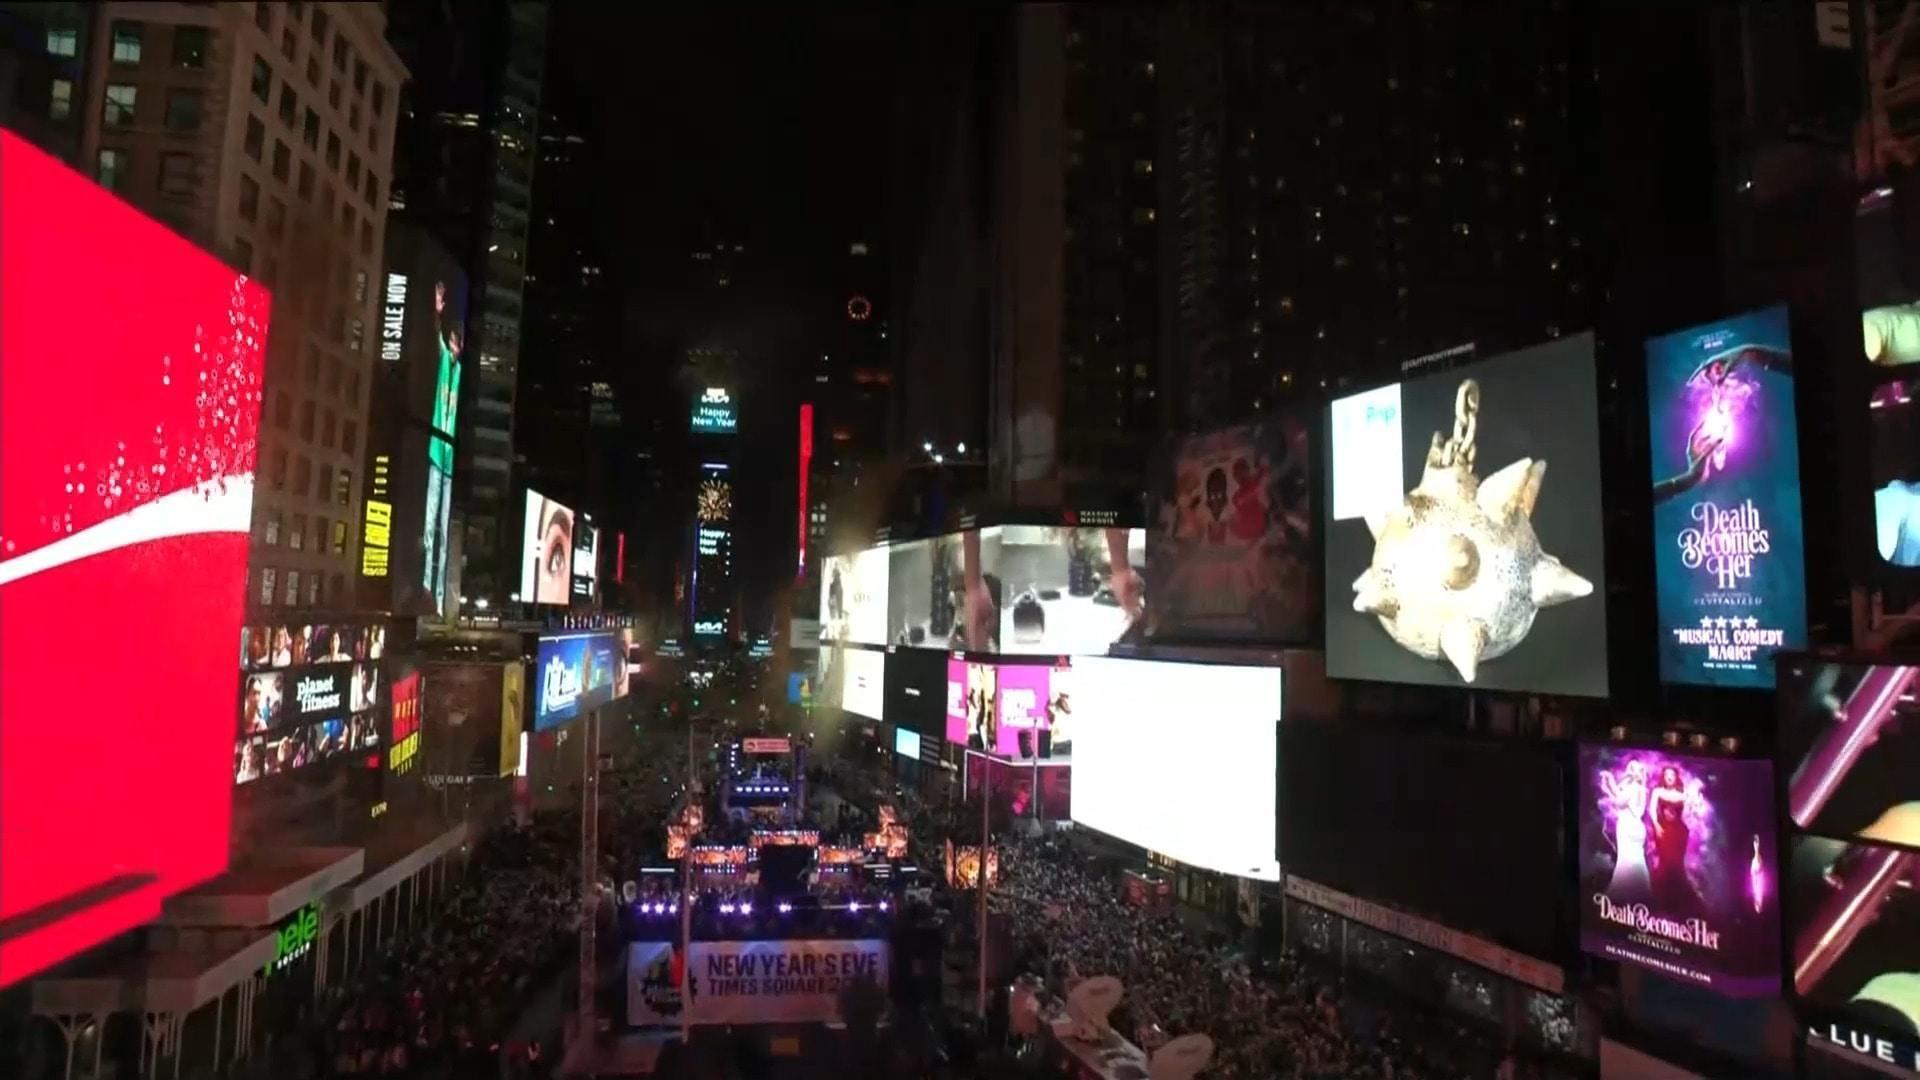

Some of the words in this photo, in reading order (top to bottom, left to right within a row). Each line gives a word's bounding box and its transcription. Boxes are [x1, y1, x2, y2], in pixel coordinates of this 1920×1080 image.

[386, 273, 407, 303] NOW
[383, 306, 404, 339] SALE
[382, 342, 401, 360] ON
[692, 415, 713, 426] New
[716, 416, 737, 428] Year
[700, 406, 730, 419] Happy
[373, 456, 389, 494] TOUR
[1691, 498, 1760, 536] Death
[1677, 528, 1770, 569] Becomes
[1706, 553, 1754, 589] Her
[1733, 629, 1784, 647] COMEDY
[296, 675, 335, 701] planet
[301, 693, 341, 713] fitness
[1593, 893, 1635, 926] Death
[1632, 903, 1693, 943] Becomes
[1686, 917, 1720, 950] Her
[707, 953, 756, 976] NEW
[761, 952, 837, 977] YEAR'S
[842, 951, 878, 976] EVE
[709, 977, 754, 996] TIMES
[761, 977, 826, 996] SQUARE
[1808, 1023, 1896, 1063] LUE
